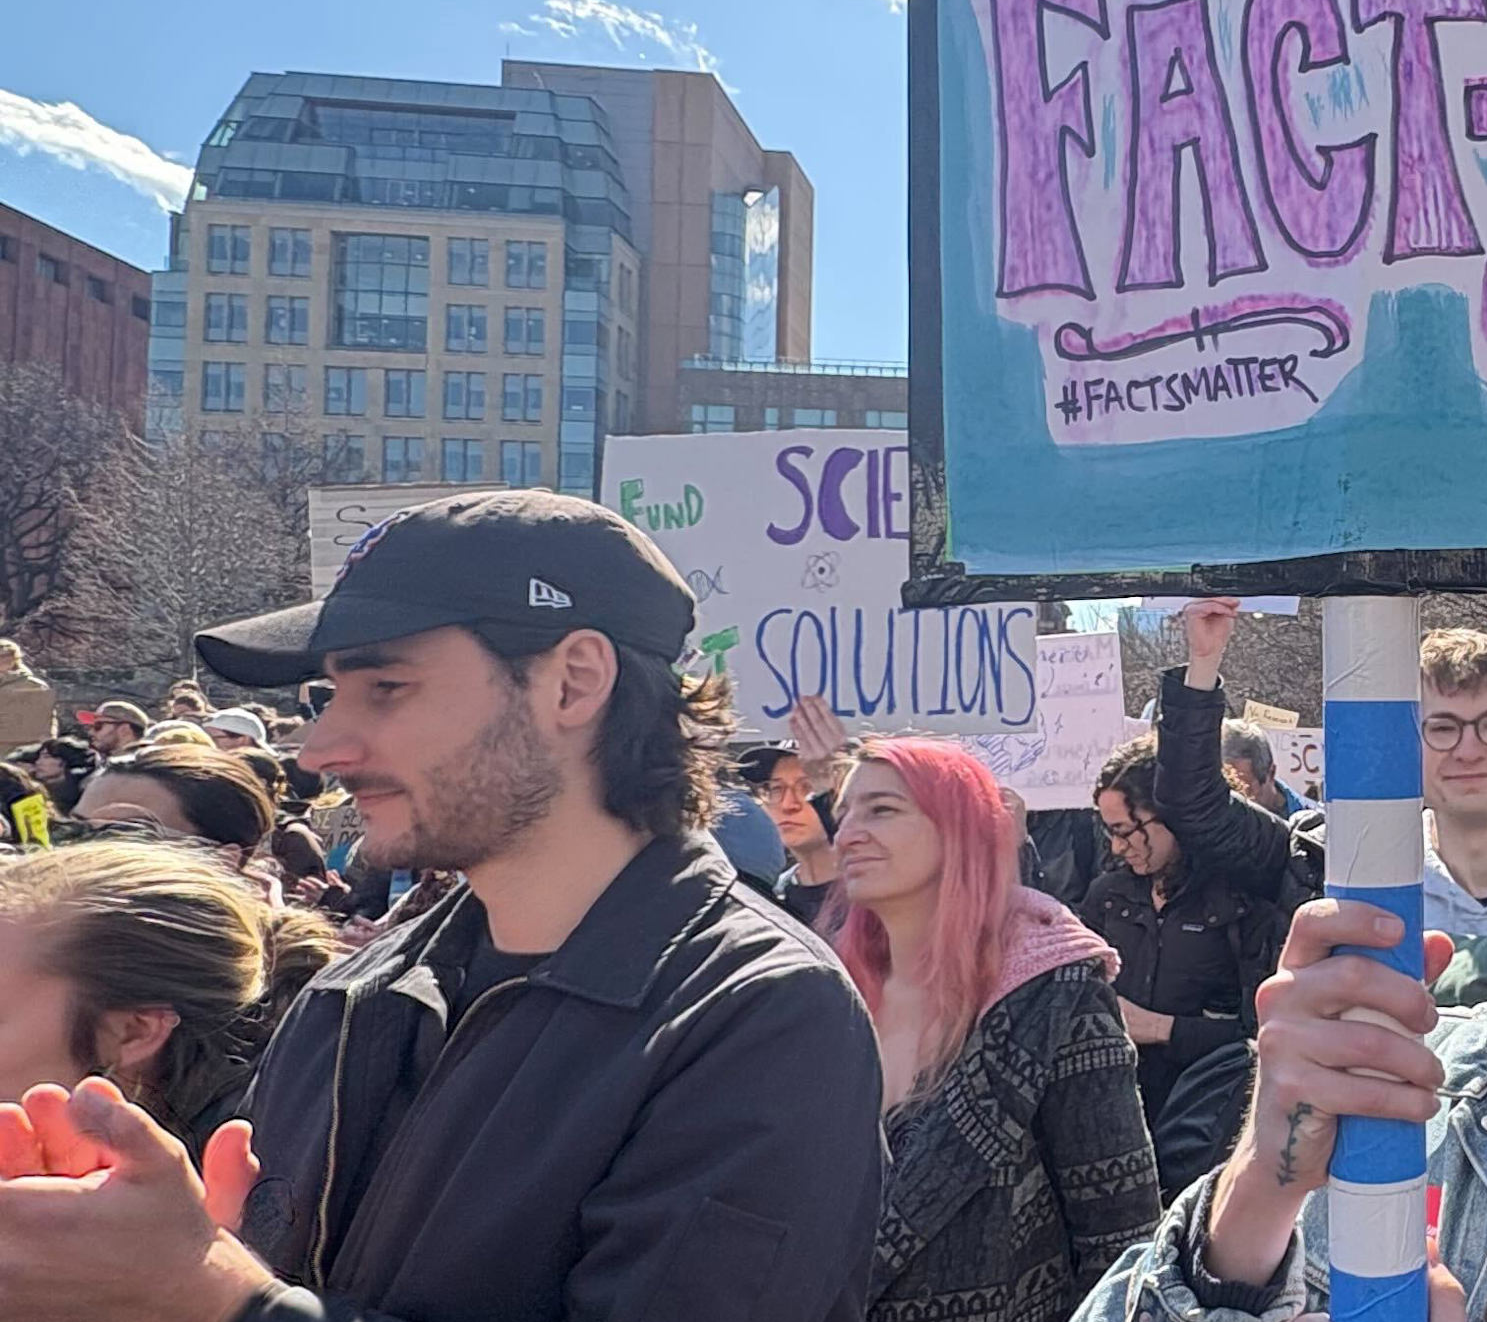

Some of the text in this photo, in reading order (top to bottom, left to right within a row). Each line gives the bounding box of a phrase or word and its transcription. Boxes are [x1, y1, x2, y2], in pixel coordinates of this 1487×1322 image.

[1054, 354, 1320, 426] #FACTSMATTER
[766, 445, 909, 545] SCIE
[755, 605, 1036, 726] SOLUTIONS
